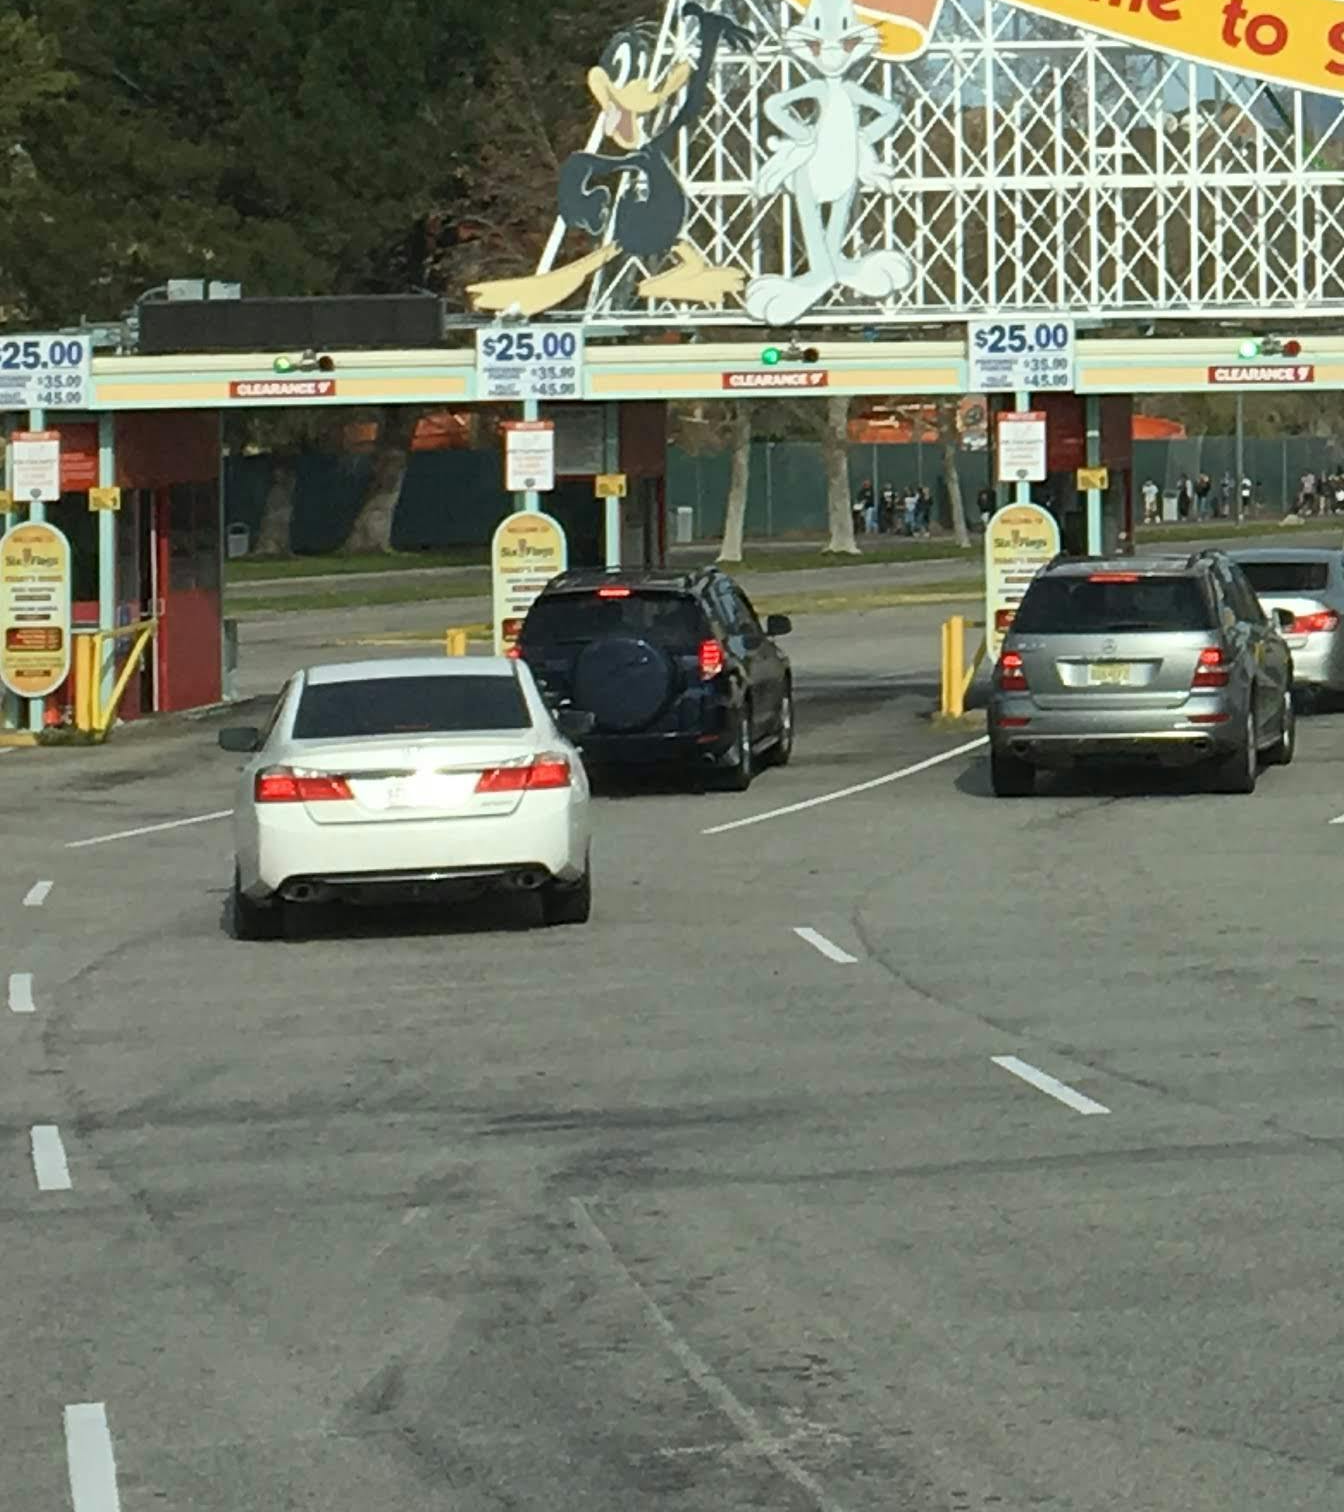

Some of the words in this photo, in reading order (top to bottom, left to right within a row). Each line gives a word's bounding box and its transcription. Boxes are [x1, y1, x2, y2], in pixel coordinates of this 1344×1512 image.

[975, 323, 1068, 352] $25.00
[483, 333, 576, 361] $25.00
[729, 374, 808, 387] CLEARANCE
[1215, 368, 1295, 381] CLEARANCE
[236, 382, 316, 396] CLEARANCE
